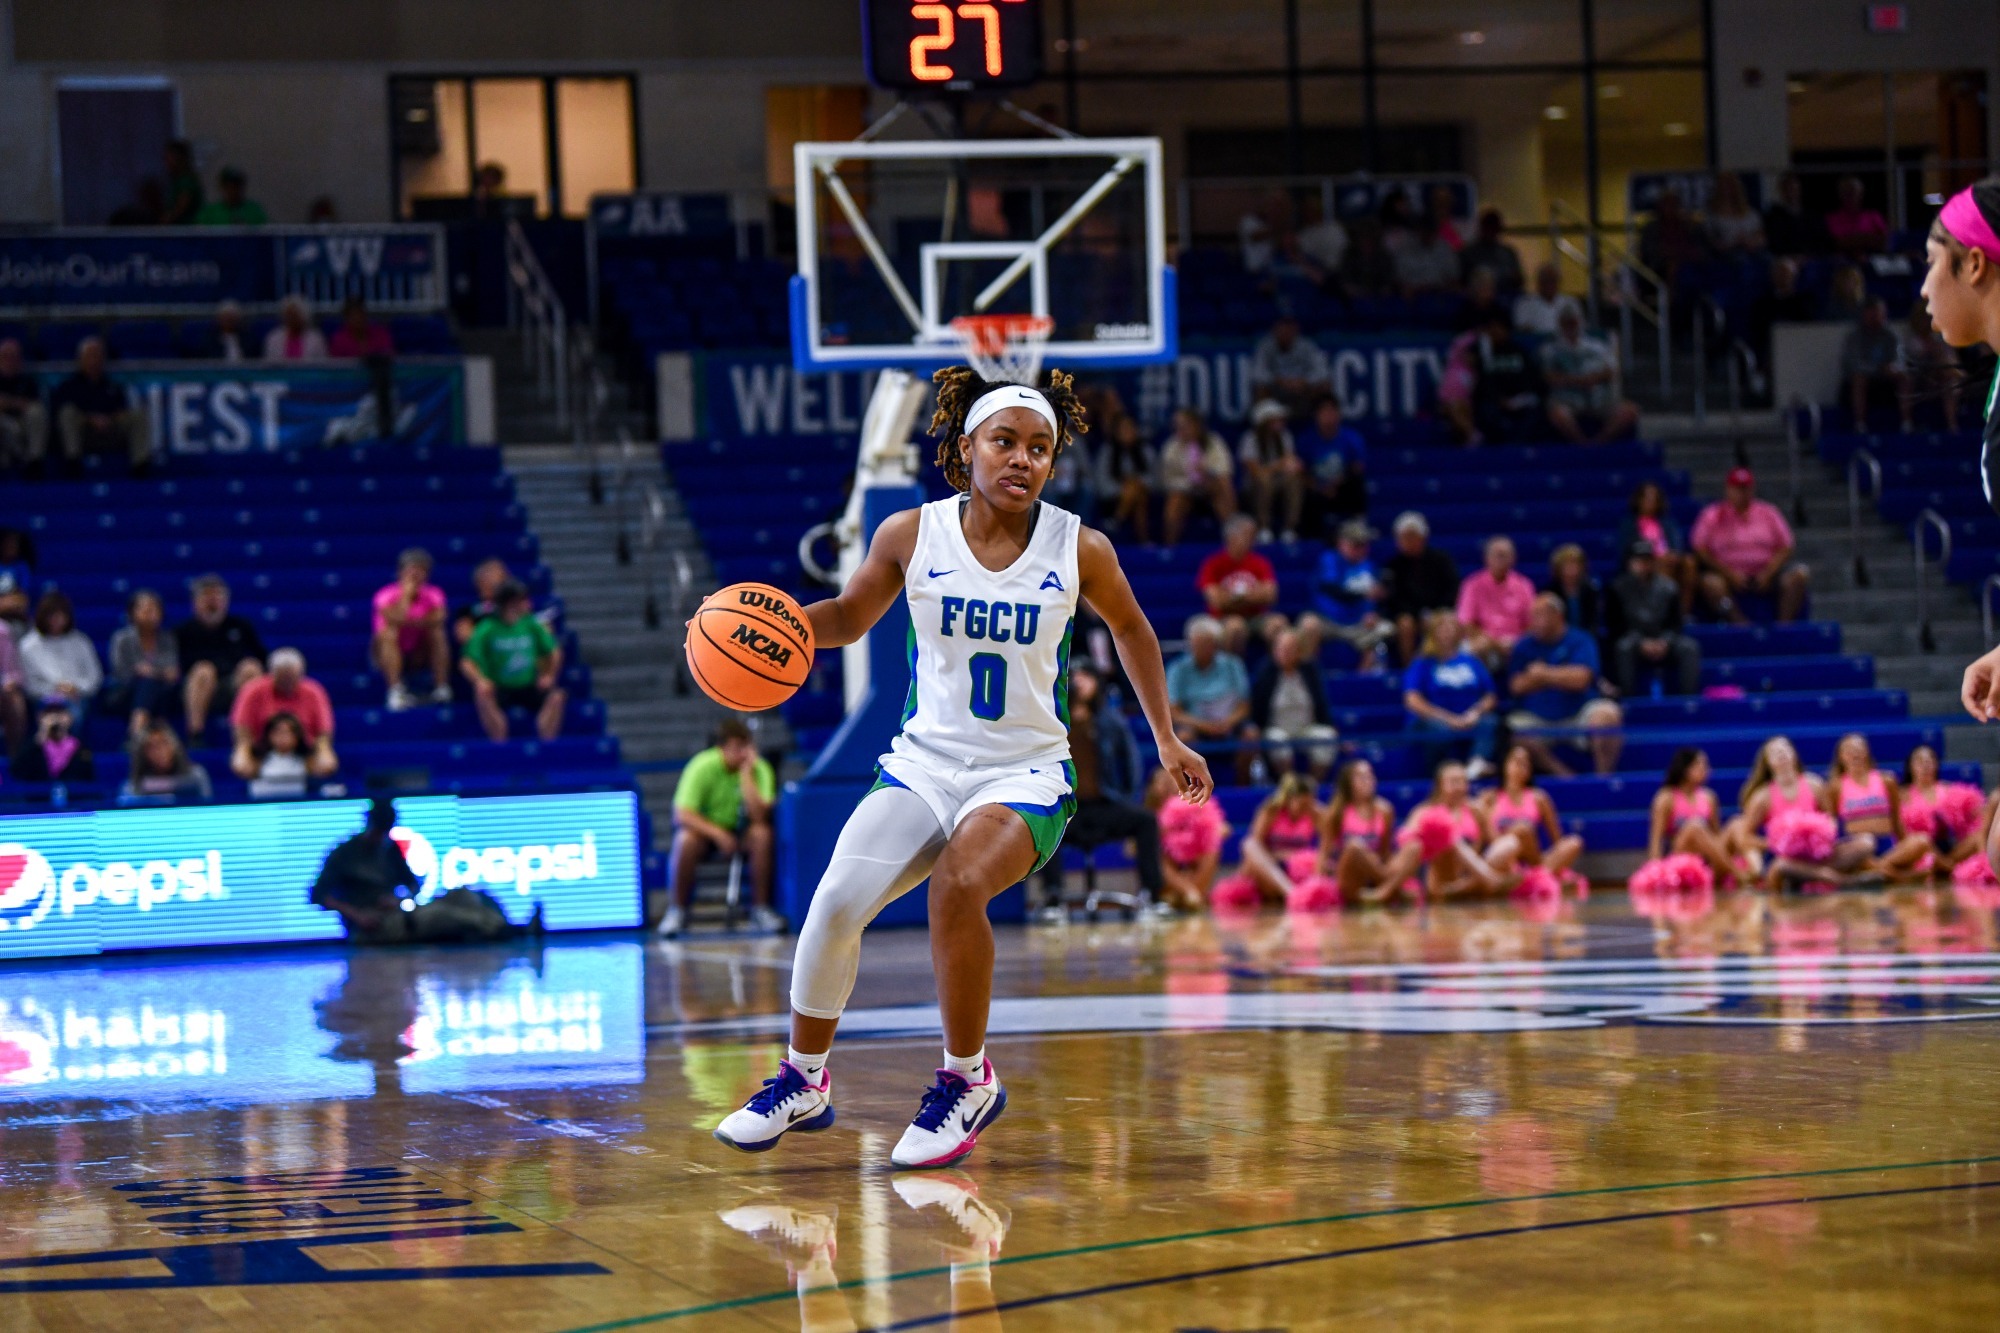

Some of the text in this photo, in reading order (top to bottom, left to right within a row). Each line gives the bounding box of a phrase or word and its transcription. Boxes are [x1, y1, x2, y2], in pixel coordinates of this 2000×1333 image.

[910, 4, 1002, 81] 27
[730, 623, 792, 669] NCAA
[739, 590, 809, 645] Wilson
[940, 595, 1042, 646] FGCU
[968, 651, 1008, 722] 0
[60, 849, 223, 911] pepsi
[442, 829, 599, 896] pepsi
